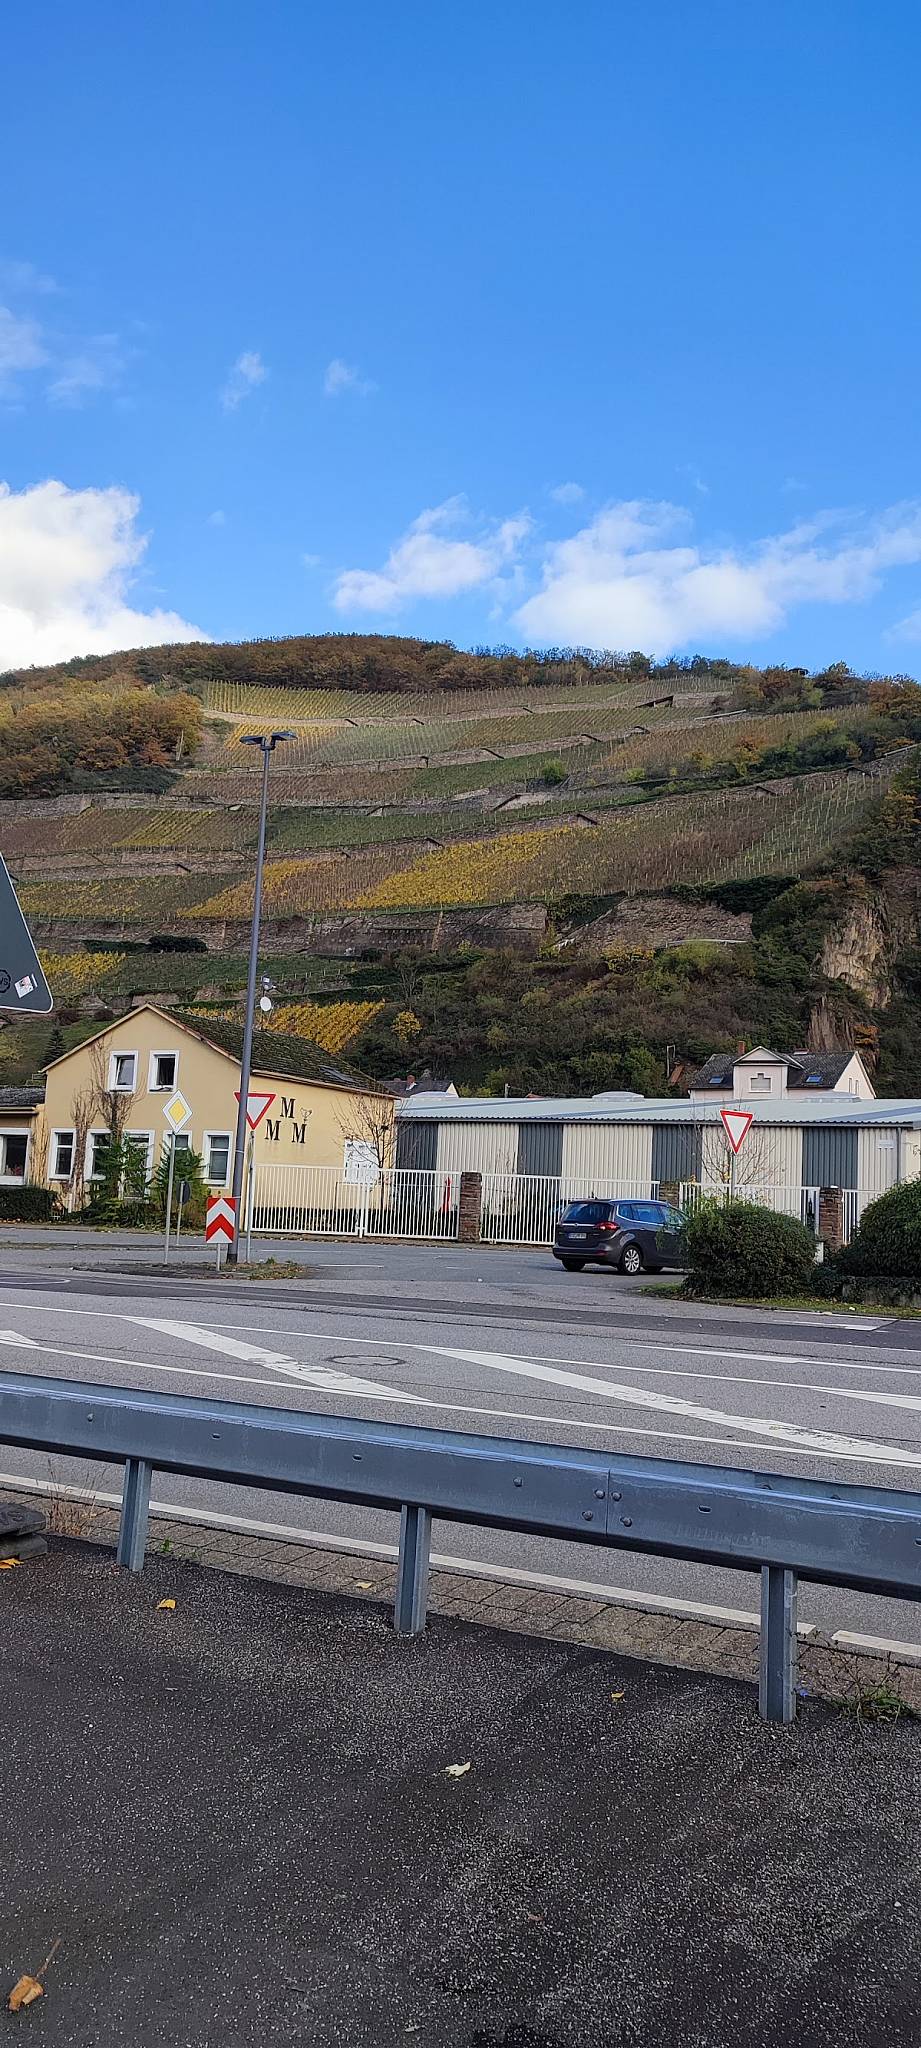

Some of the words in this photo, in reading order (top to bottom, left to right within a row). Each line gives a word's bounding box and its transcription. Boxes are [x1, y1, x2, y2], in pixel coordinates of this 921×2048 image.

[279, 1096, 296, 1118] M
[264, 1119, 281, 1141] M
[291, 1122, 307, 1144] M
